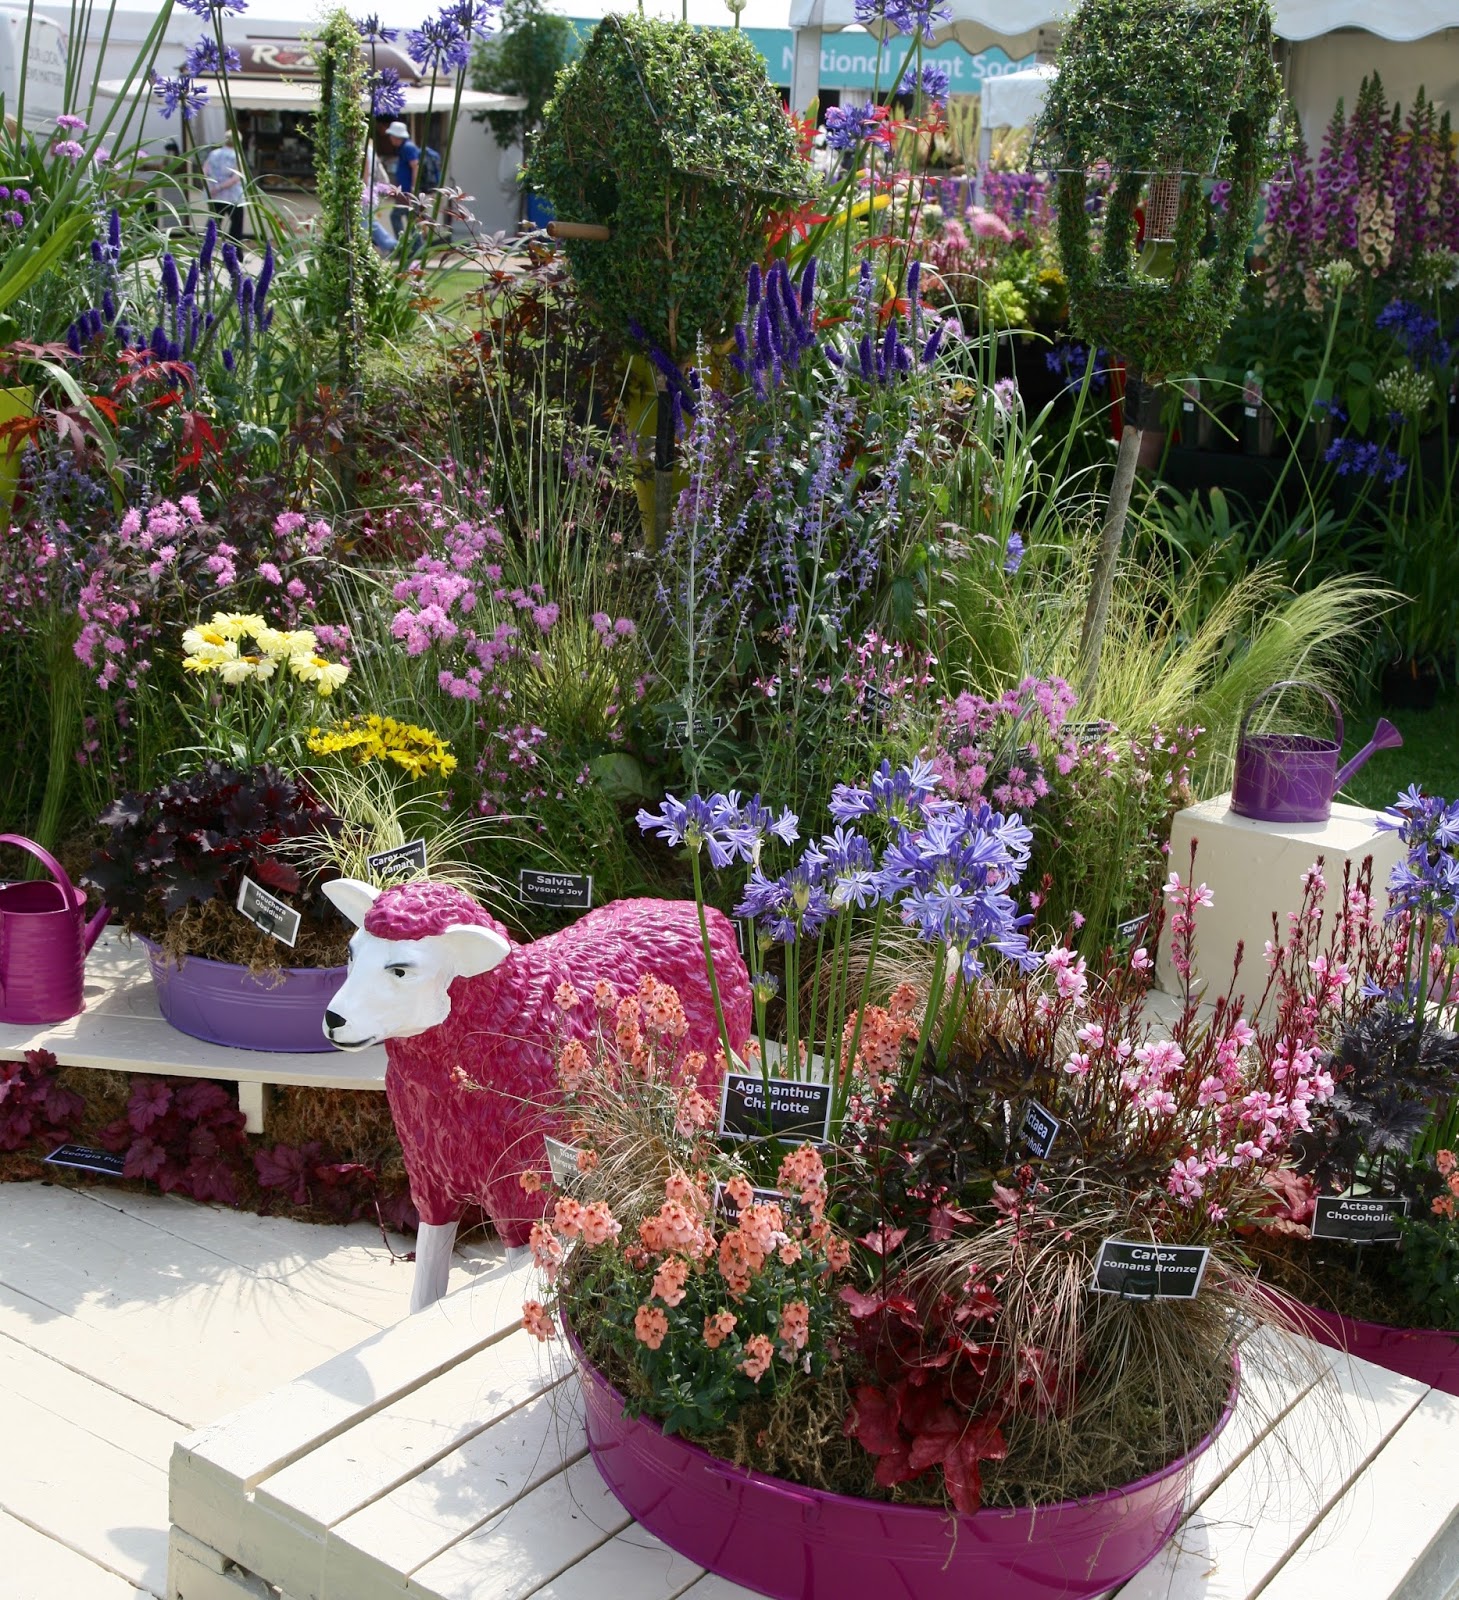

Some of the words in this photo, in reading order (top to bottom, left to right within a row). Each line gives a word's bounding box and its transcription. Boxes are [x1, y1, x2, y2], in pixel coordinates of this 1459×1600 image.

[782, 46, 891, 74] Ntional
[371, 853, 398, 867] Carex
[536, 875, 574, 887] Salvia
[527, 884, 565, 895] Dyson's
[566, 888, 583, 896] Joy
[256, 890, 287, 915] Heuchera
[255, 899, 284, 922] Obsidian
[743, 1097, 810, 1114] Charlotte
[61, 1150, 101, 1160] Georgia
[1340, 1201, 1383, 1211] Actaea
[1326, 1211, 1395, 1222] Chocoholic
[1131, 1249, 1177, 1262] Carex
[1103, 1260, 1151, 1272] comans
[1154, 1264, 1198, 1273] Bronze
